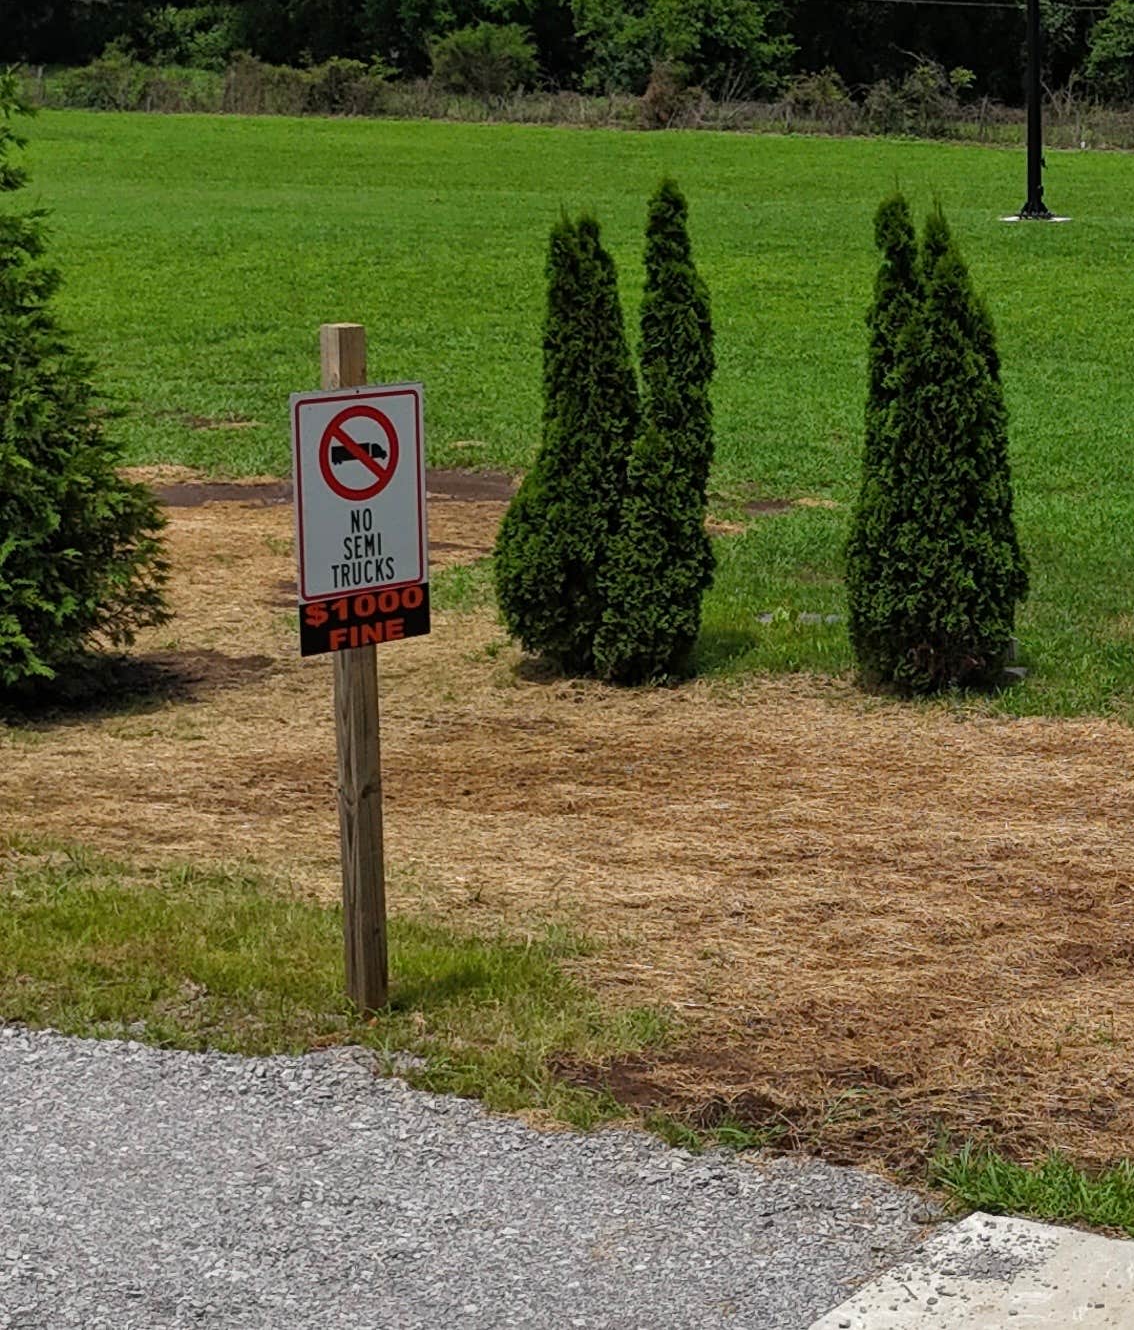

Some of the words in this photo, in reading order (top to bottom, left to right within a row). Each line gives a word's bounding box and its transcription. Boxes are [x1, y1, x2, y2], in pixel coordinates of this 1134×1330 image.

[350, 508, 373, 534] NO
[343, 532, 382, 561] SEMI
[331, 556, 395, 589] TRUCKS
[304, 585, 424, 627] $1000
[329, 618, 405, 651] FINE
